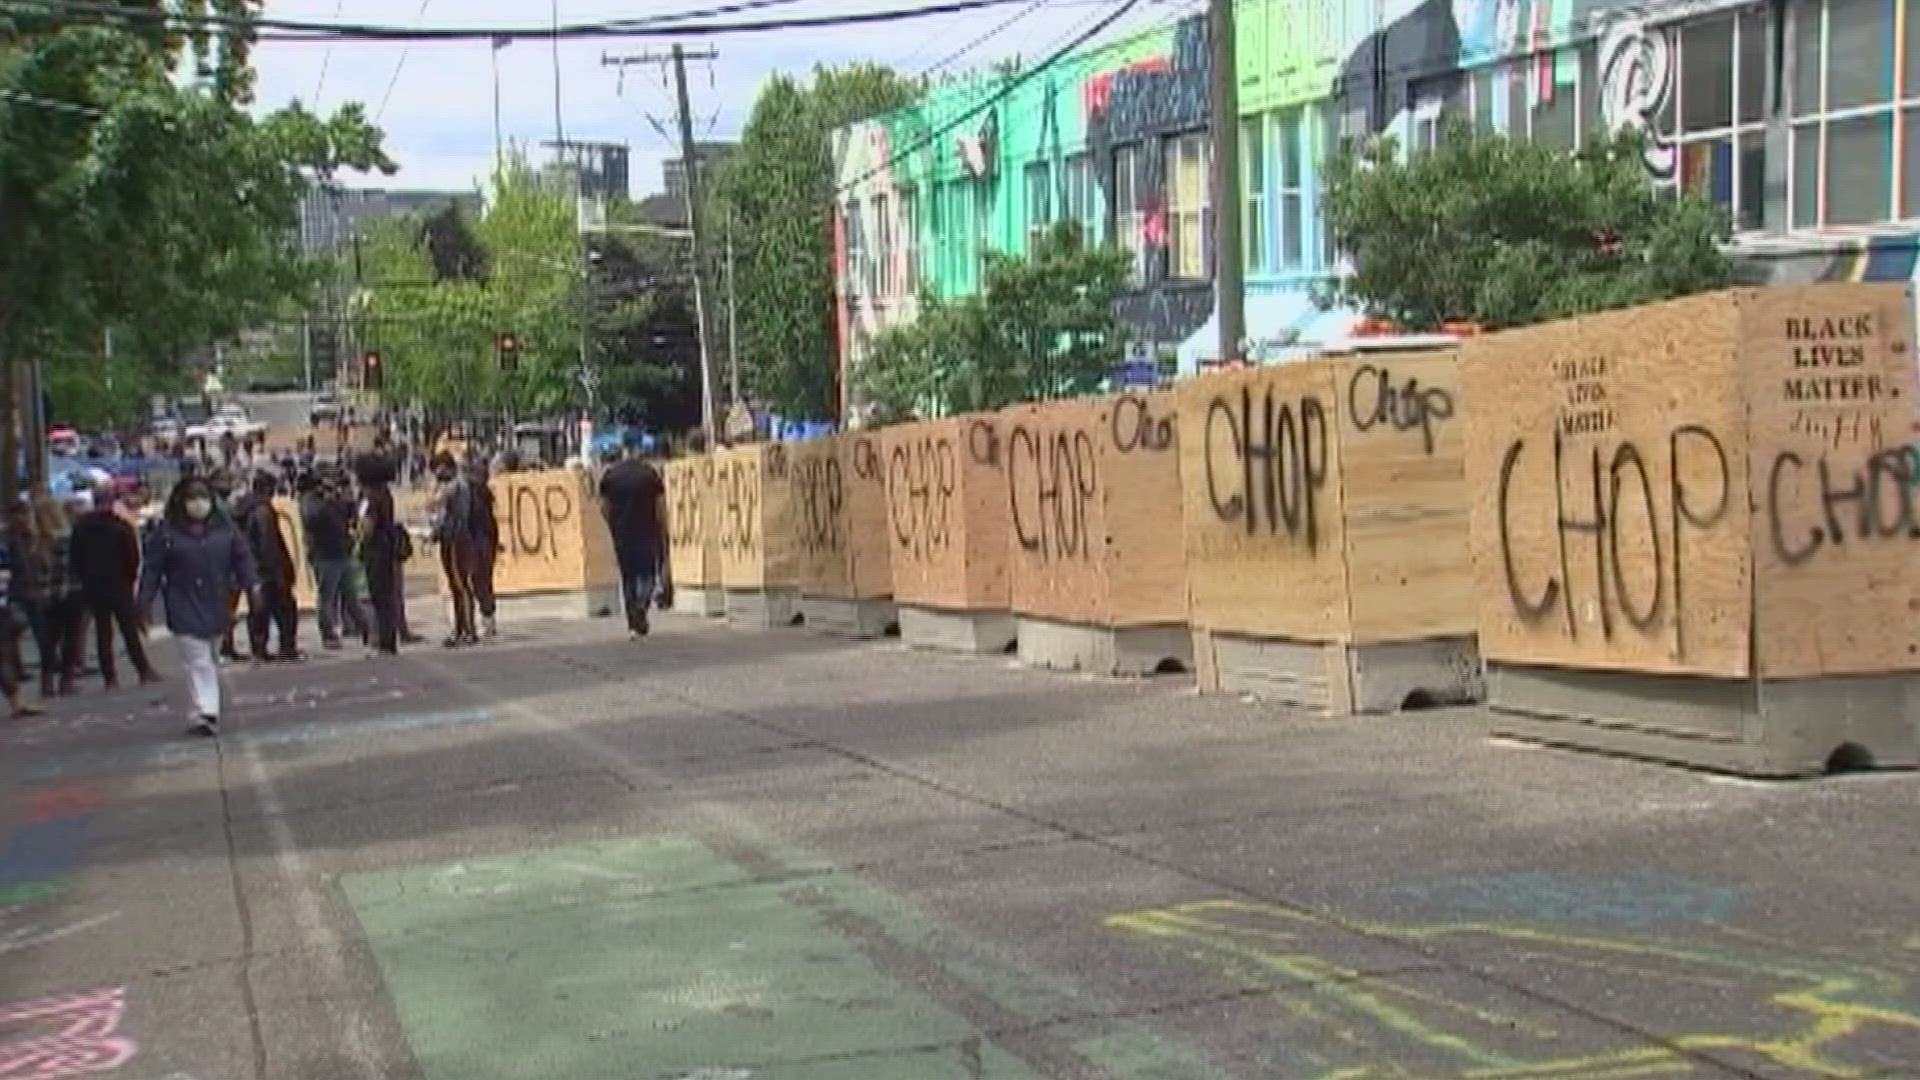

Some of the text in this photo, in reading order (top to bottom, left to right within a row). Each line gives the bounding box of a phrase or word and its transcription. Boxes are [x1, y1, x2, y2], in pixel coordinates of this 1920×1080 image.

[1786, 315, 1871, 340] BLACK
[1794, 346, 1864, 368] LIVES
[1112, 394, 1178, 453] Cho
[1783, 375, 1883, 402] MATTER
[889, 437, 955, 562] CHOP
[1008, 426, 1097, 564] CHOP
[1204, 382, 1328, 561] CHOP
[496, 483, 572, 561] HOP
[1501, 425, 1729, 659] CHOP
